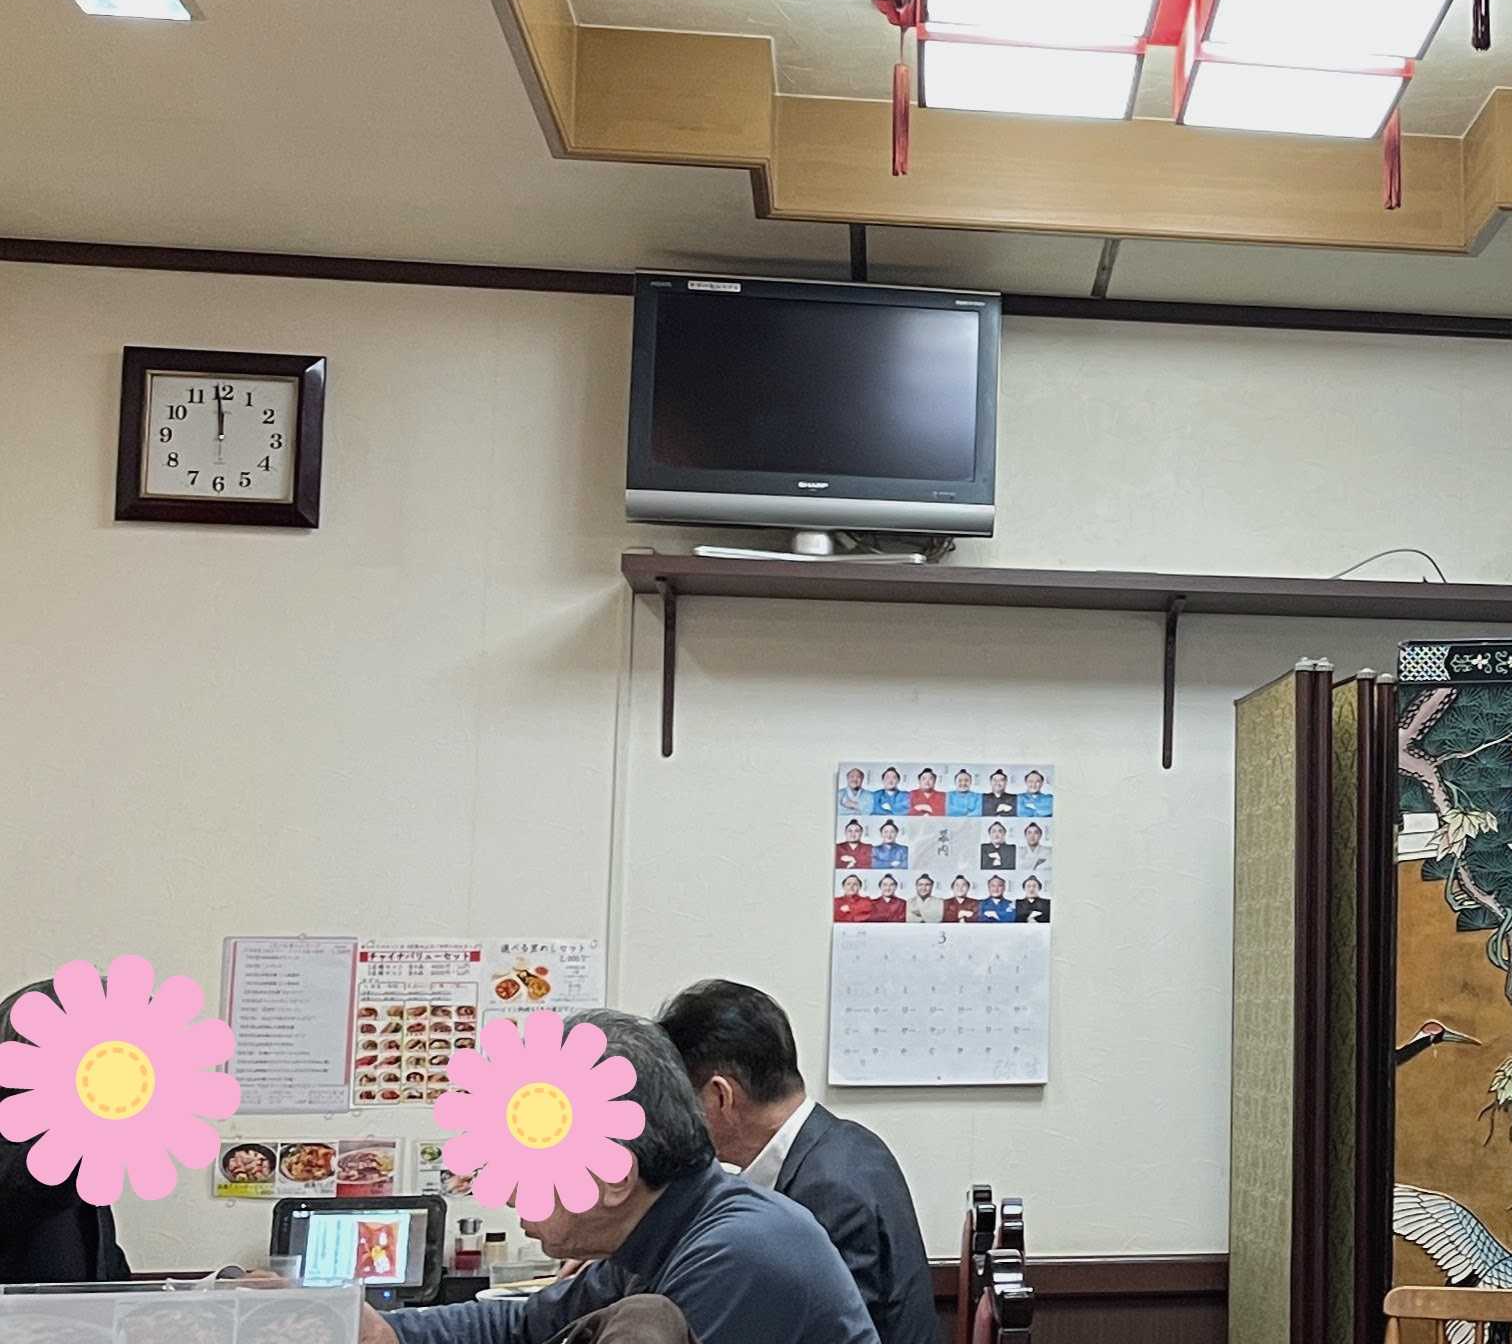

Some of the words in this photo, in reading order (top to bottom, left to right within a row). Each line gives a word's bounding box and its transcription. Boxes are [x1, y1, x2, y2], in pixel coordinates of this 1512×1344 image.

[187, 388, 204, 404] 11
[213, 385, 234, 400] 12
[245, 392, 253, 407] 1
[167, 405, 187, 420] 10
[262, 409, 275, 424] 2
[160, 427, 172, 442] 9
[270, 433, 282, 449] 3
[167, 452, 179, 467] 8
[257, 456, 271, 471] 4
[187, 471, 199, 485] 7
[212, 476, 225, 492] 6
[239, 472, 251, 487] 5
